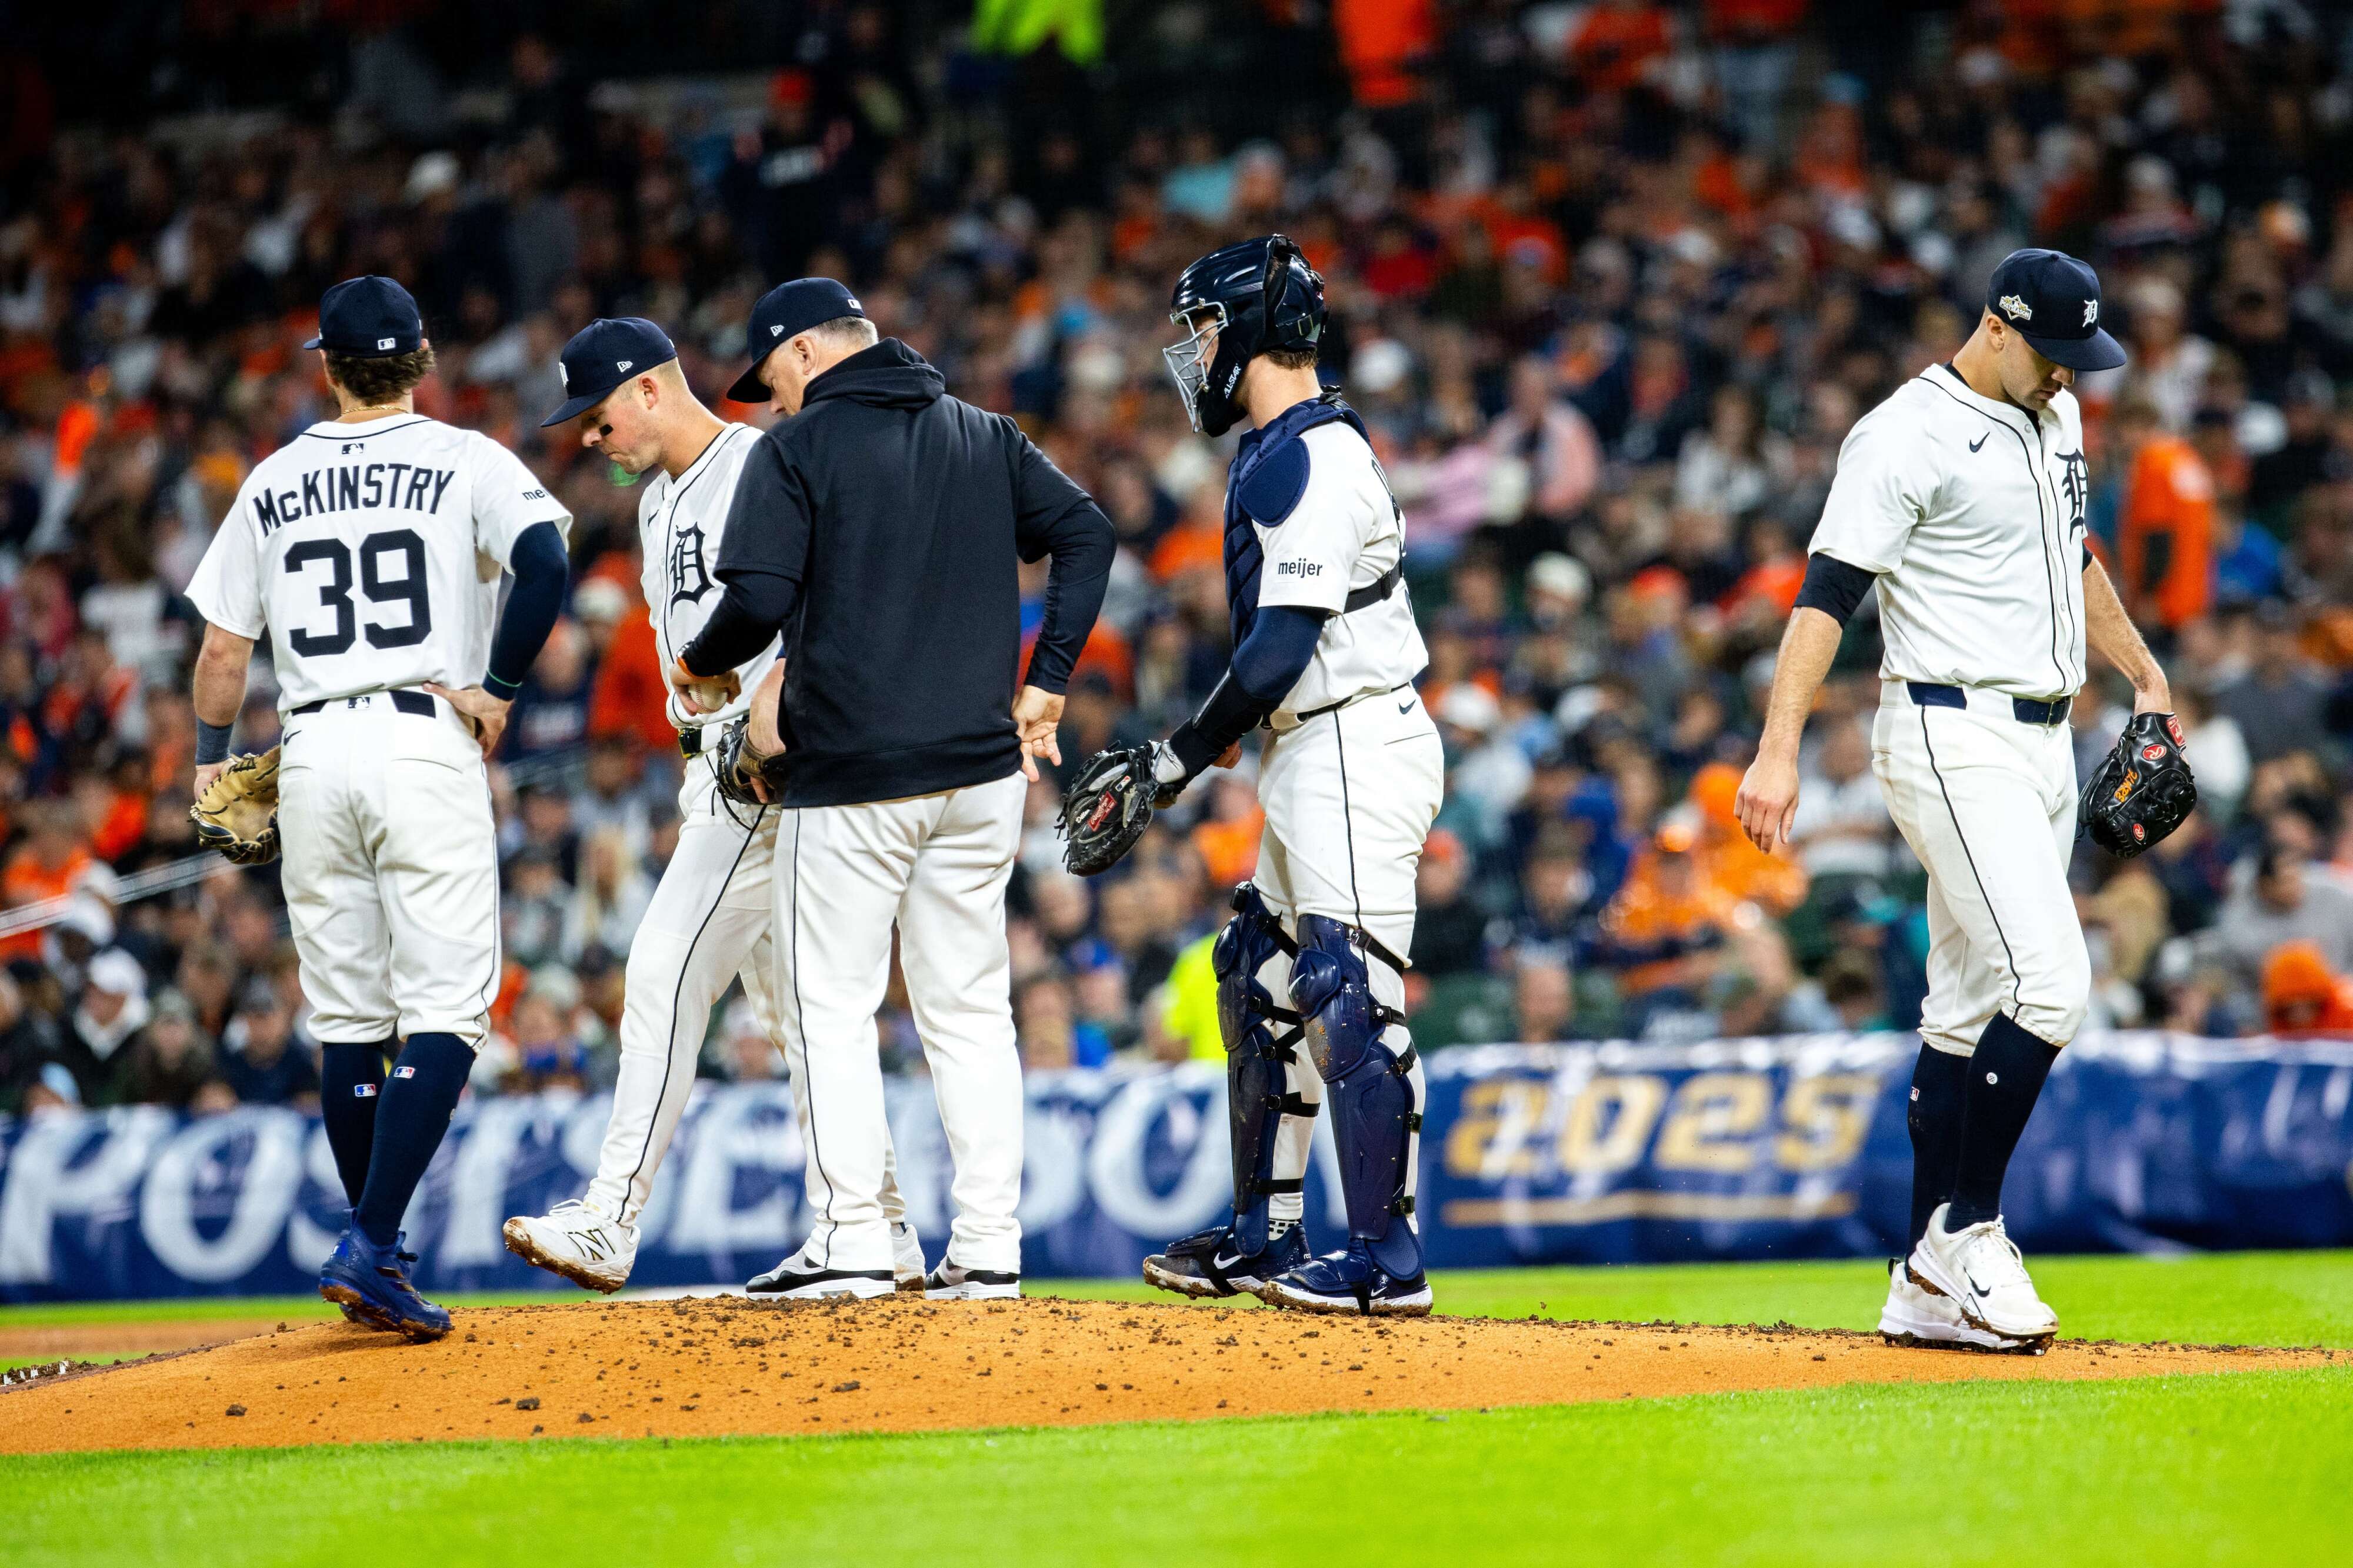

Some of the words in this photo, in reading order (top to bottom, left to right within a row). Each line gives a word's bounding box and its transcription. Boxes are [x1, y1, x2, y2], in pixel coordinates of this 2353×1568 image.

[253, 463, 455, 538] McKINSTRY
[284, 528, 432, 658] 39
[1278, 558, 1323, 578] meijer
[1446, 1074, 1882, 1174] 2025
